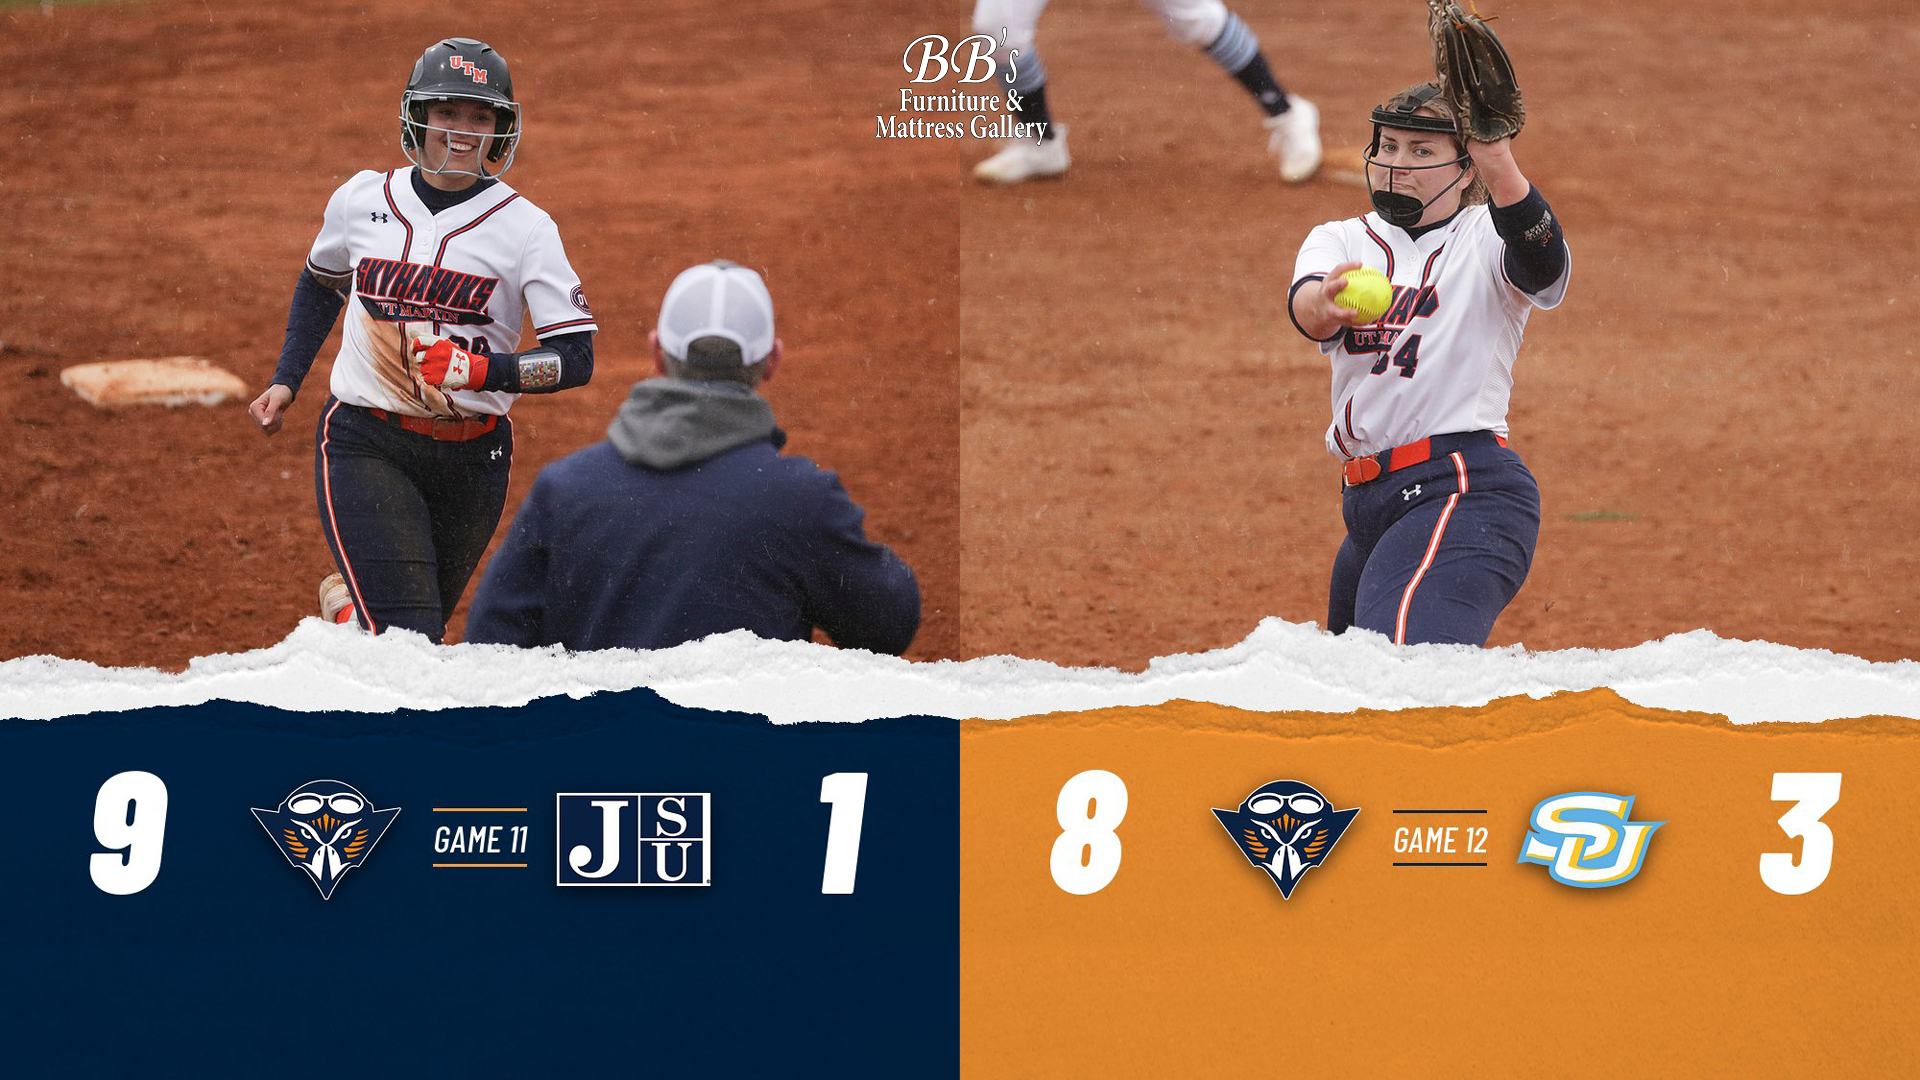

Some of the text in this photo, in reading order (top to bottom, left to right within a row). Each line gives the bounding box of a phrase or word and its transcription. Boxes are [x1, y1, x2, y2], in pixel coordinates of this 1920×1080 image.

[450, 56, 487, 84] UTM
[356, 257, 499, 312] SKYHAWKS
[399, 304, 460, 323] MARTIN
[1354, 331, 1376, 346] UT
